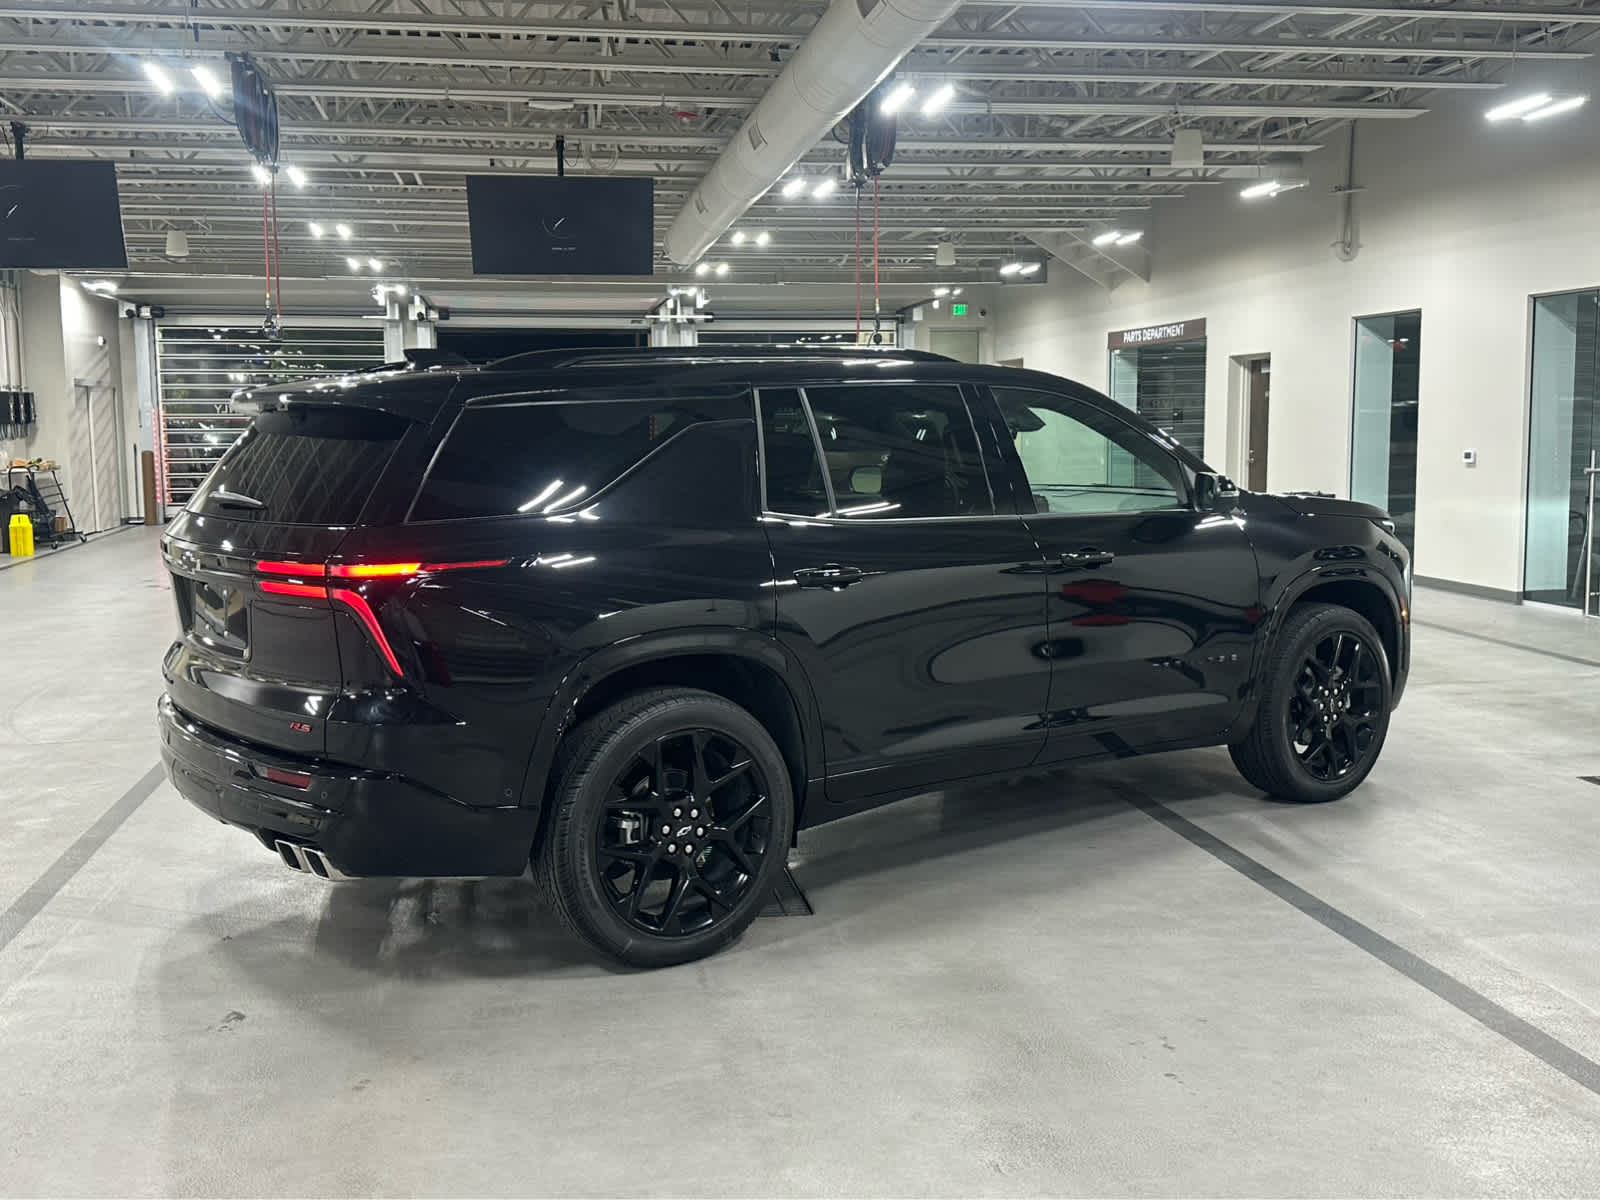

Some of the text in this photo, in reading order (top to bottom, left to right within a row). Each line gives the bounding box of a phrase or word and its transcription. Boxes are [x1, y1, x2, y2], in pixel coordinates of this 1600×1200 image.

[1123, 324, 1184, 343] PARTS DEPARTMENT
[290, 722, 311, 733] RS
